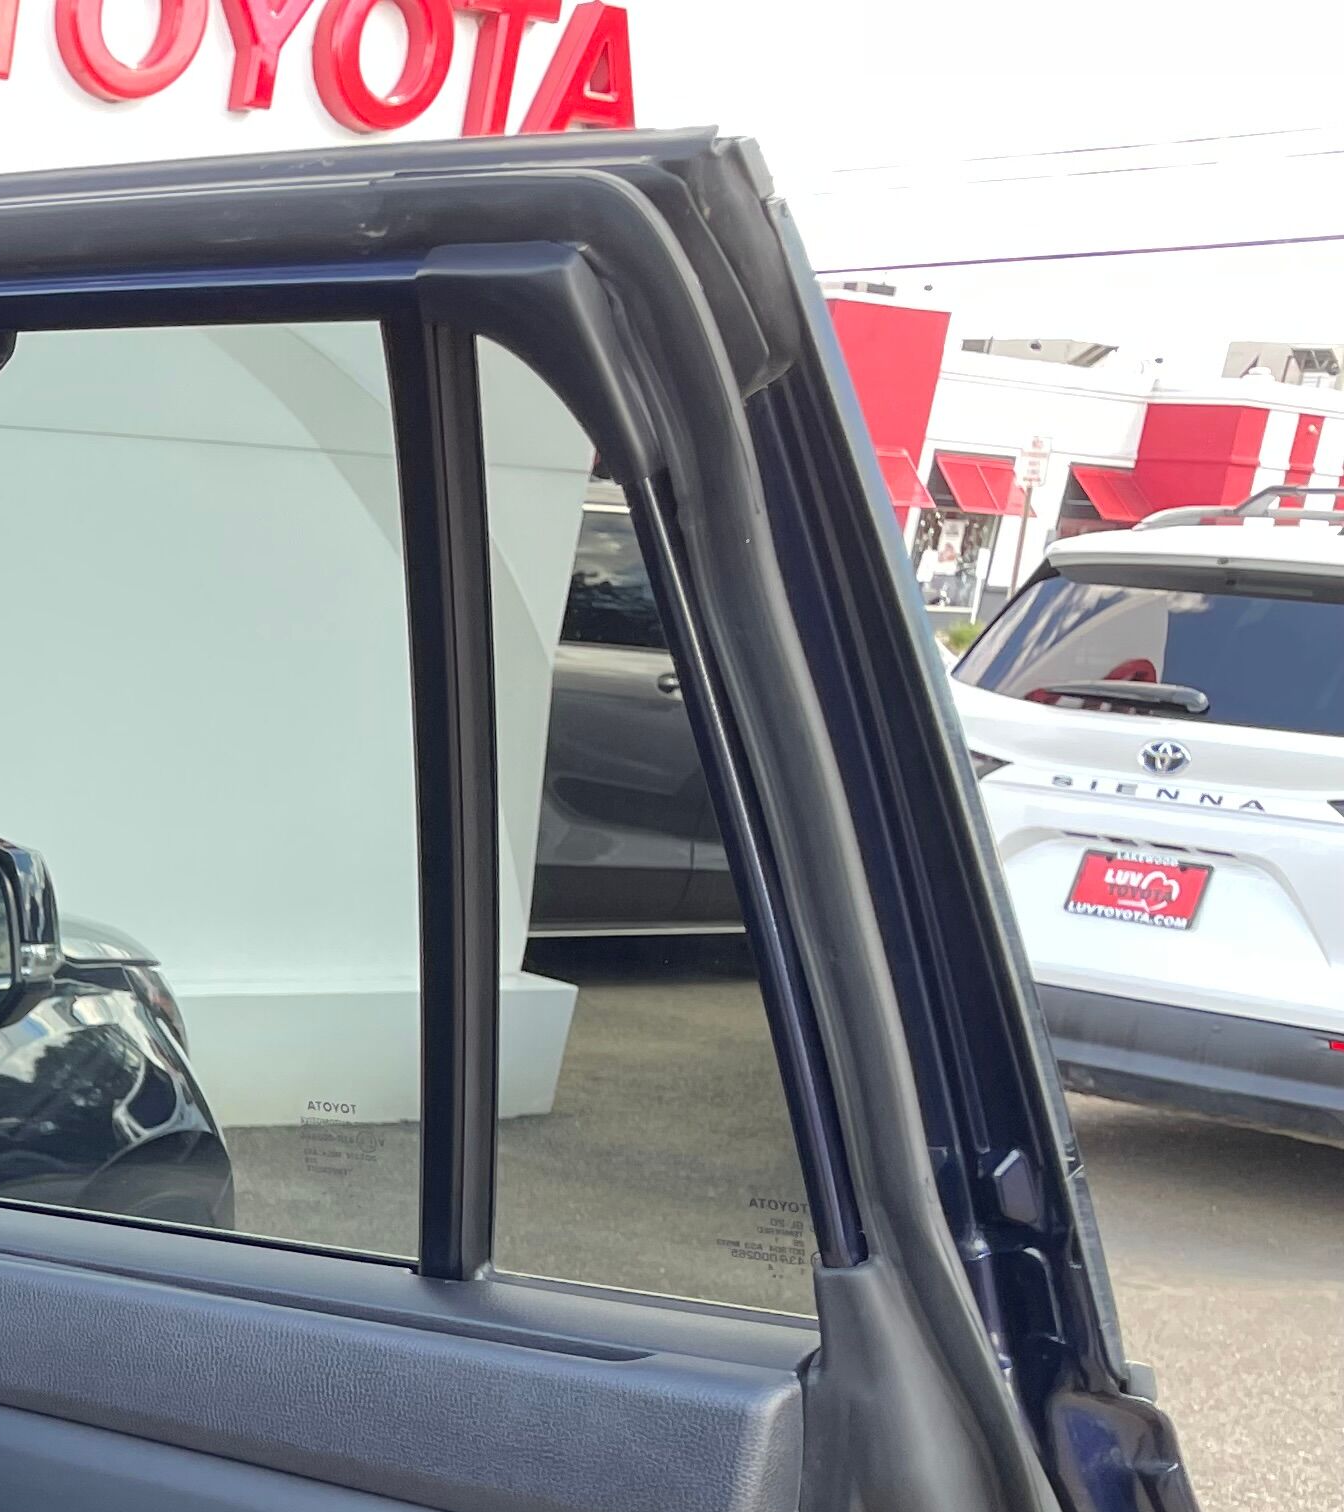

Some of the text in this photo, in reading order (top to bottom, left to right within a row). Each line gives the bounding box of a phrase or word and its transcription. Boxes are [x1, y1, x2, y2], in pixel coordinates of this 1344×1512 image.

[1052, 774, 1265, 812] SIENNA
[1104, 868, 1144, 887] LUV
[1067, 900, 1187, 929] LUVTOYOTA.COM
